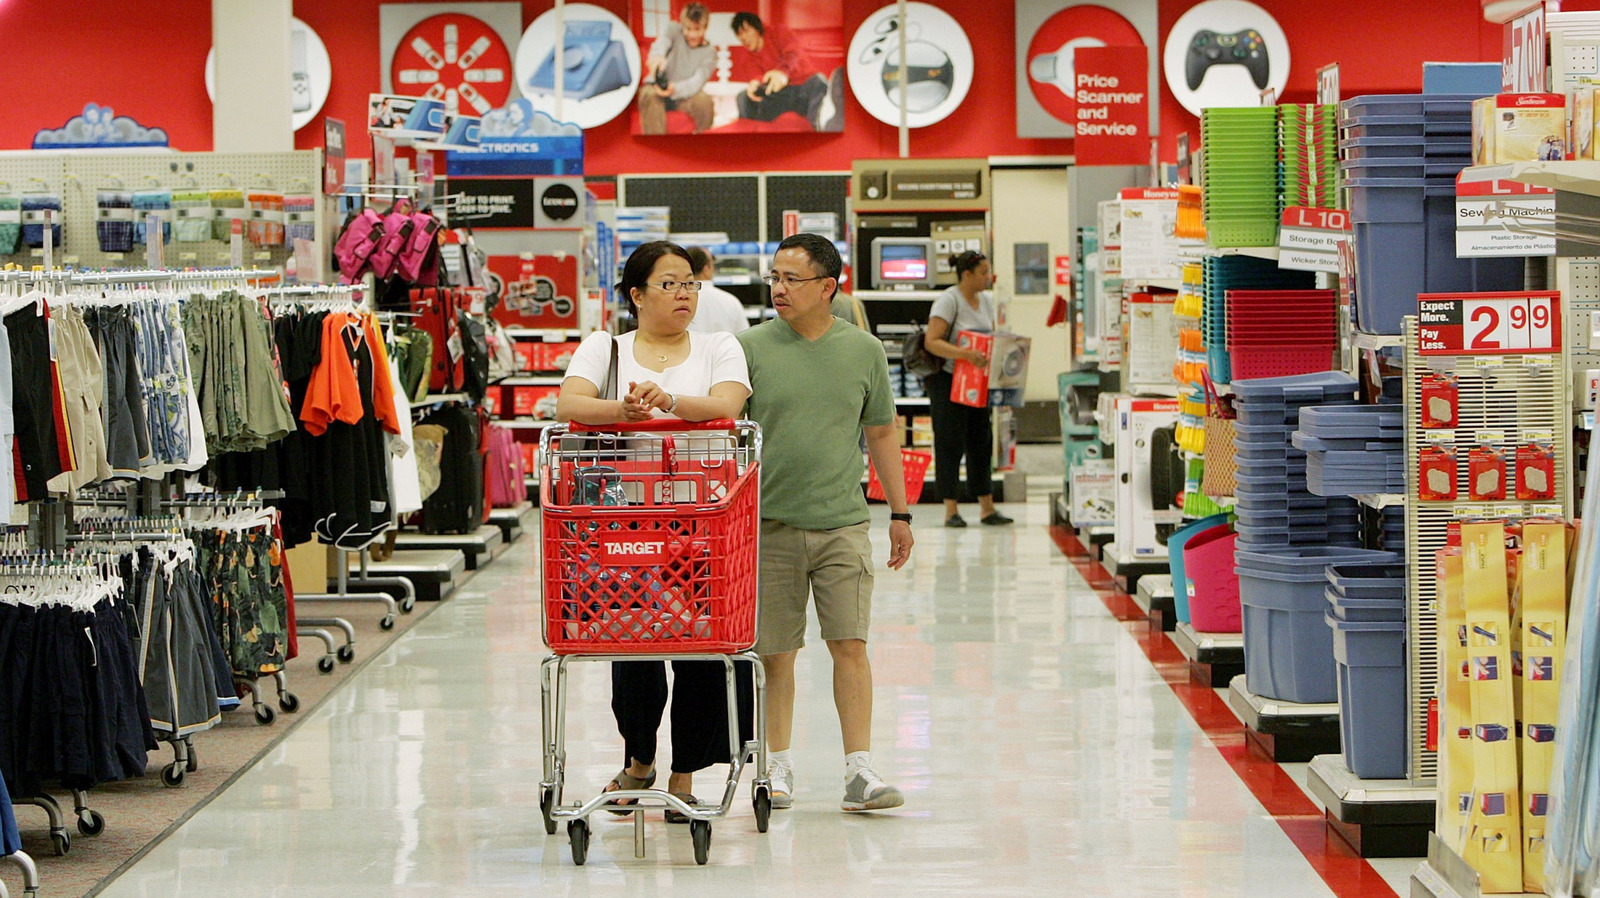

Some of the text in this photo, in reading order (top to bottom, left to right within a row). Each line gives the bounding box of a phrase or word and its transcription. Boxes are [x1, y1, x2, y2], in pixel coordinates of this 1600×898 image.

[1077, 74, 1119, 88] Price
[1077, 90, 1144, 104] Scanner
[1077, 106, 1108, 119] and
[1077, 121, 1137, 136] Service
[1144, 190, 1179, 199] Honeyw
[1509, 207, 1555, 216] Machin
[1299, 210, 1345, 229] L 10
[1289, 235, 1338, 246] Storage Bo
[1319, 258, 1339, 266] Stora
[1420, 301, 1455, 311] Expect
[1421, 313, 1449, 322] More.
[1421, 329, 1439, 340] Pay
[1421, 341, 1447, 350] Less.
[604, 542, 664, 555] TARGET
